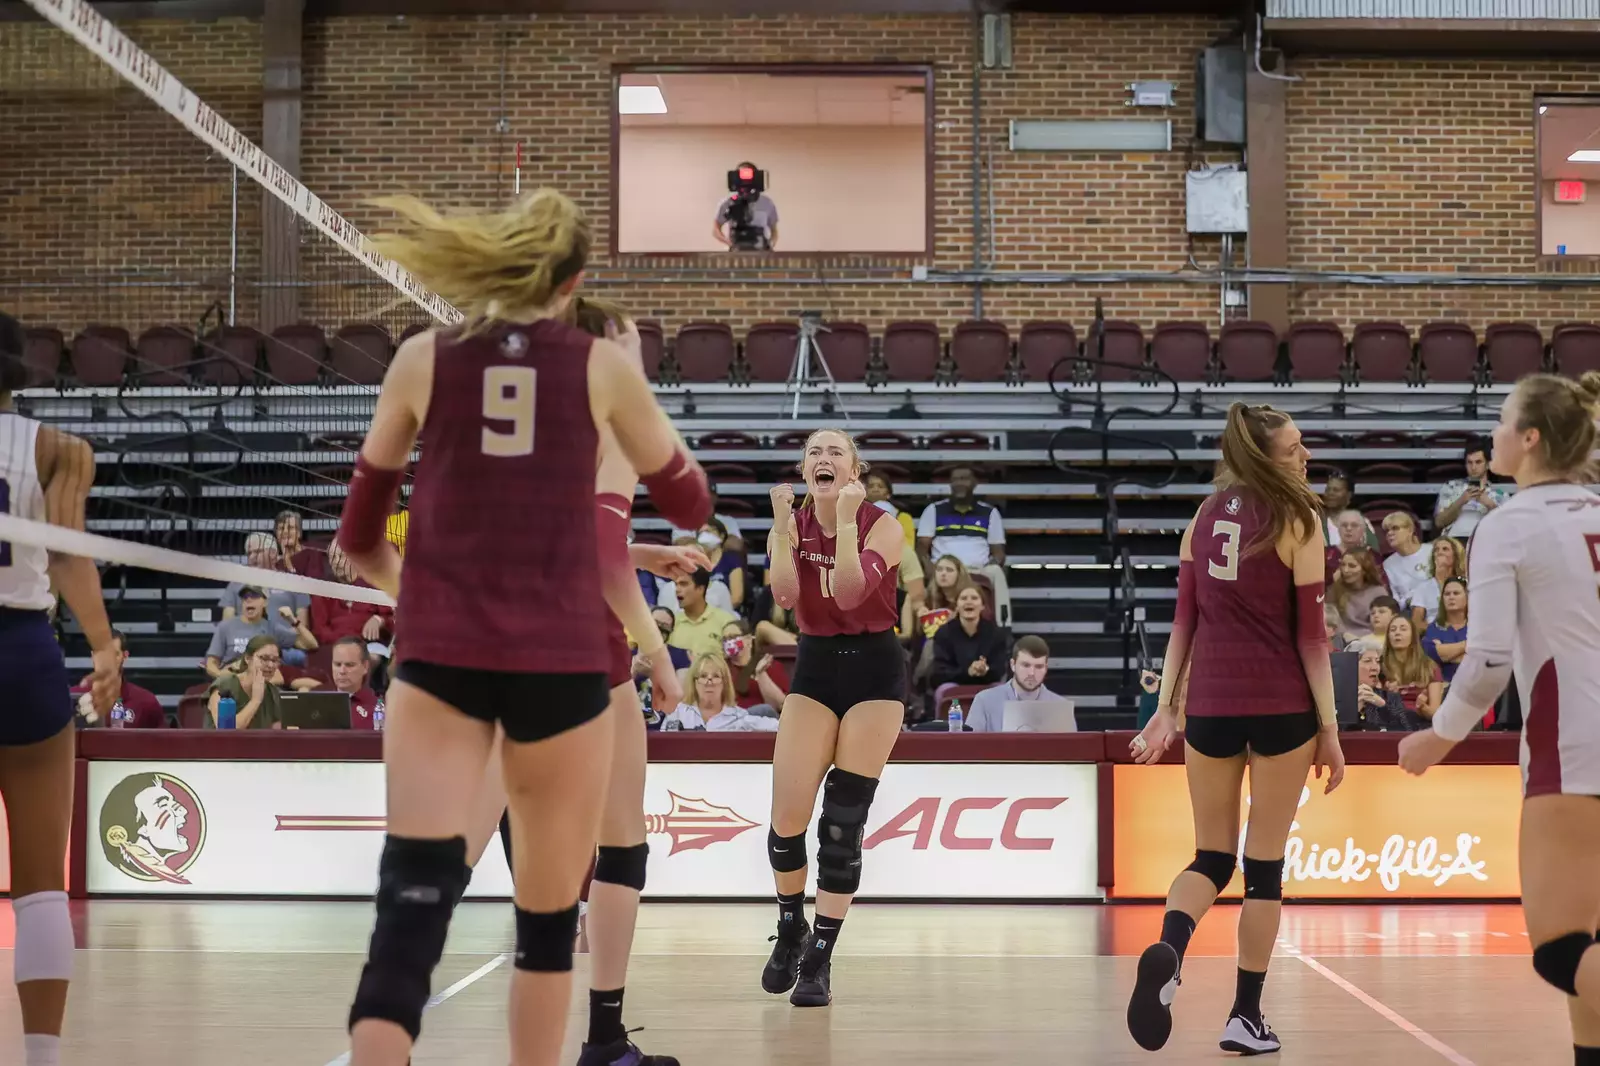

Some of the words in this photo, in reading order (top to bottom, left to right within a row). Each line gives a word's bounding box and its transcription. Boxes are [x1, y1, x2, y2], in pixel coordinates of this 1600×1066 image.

[482, 366, 537, 457] 9
[800, 550, 836, 565] FLORIDA
[1208, 520, 1241, 580] 3
[862, 797, 1069, 850] ACC
[1238, 820, 1488, 891] hick-fil-A
